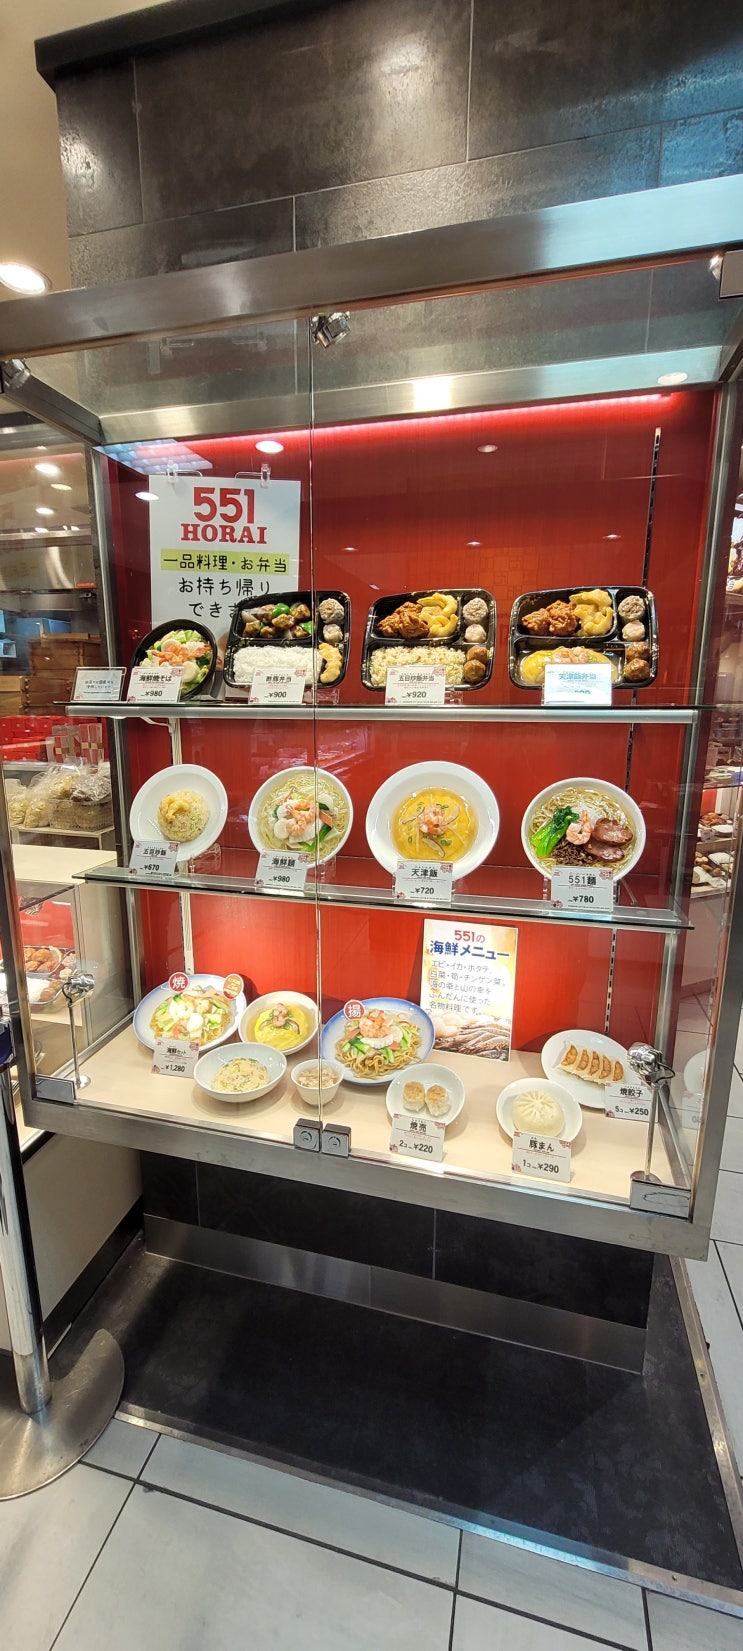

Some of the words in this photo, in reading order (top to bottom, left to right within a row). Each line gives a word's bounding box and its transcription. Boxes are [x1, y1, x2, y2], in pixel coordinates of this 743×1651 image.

[193, 487, 255, 524] 551
[180, 523, 267, 544] HORAI
[163, 553, 287, 573] 一品料理・お弁当
[178, 577, 270, 597] お持ち帰り
[143, 863, 160, 871] ¥670
[411, 868, 438, 878] 天津飯
[273, 875, 290, 883] ¥980
[415, 887, 435, 895] ¥720
[572, 895, 594, 904] ¥780
[454, 930, 486, 943] 551の
[429, 940, 510, 960] 海鮮メニュー
[172, 977, 186, 989] 焼
[348, 1004, 363, 1018] 揚
[629, 1107, 649, 1116] ¥250
[413, 1143, 433, 1153] ¥220
[529, 1139, 555, 1152] 豚まん
[538, 1162, 560, 1173] ¥290
